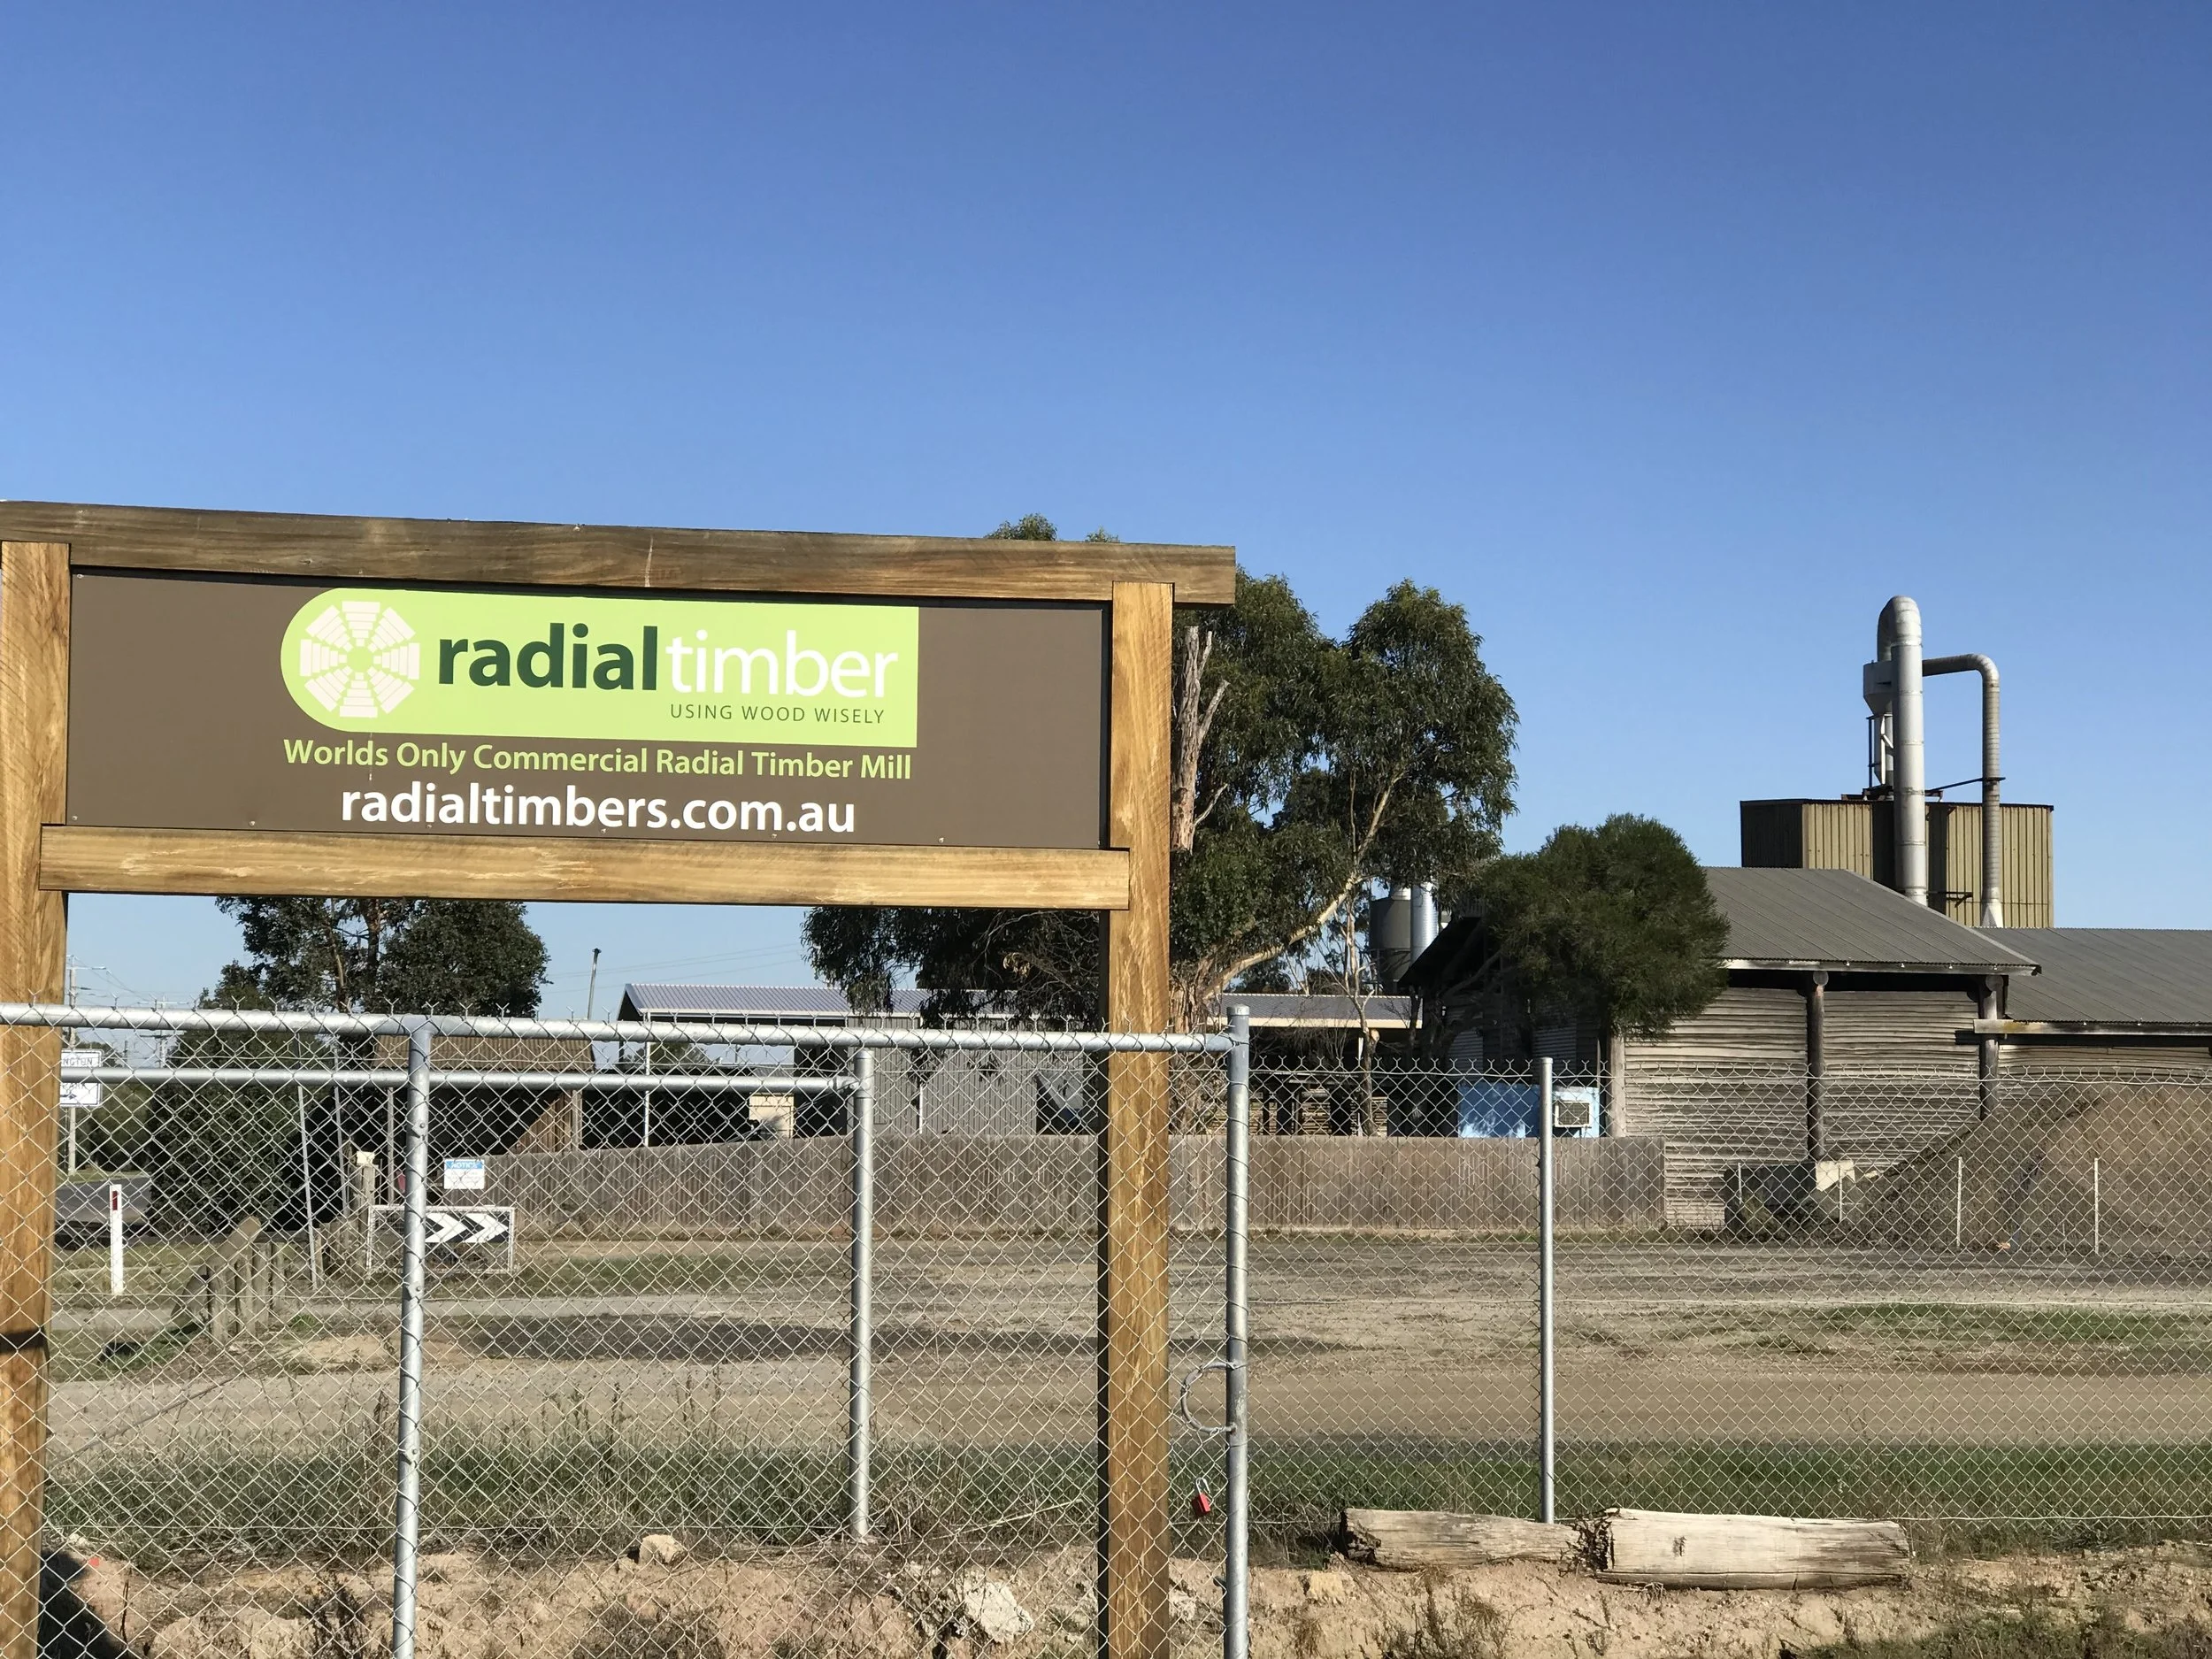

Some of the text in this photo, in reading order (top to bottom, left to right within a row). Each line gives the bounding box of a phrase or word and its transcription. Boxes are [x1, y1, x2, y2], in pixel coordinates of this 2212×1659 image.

[671, 703, 885, 725] USING WOOD WISELY
[283, 738, 911, 780] Worlds Only Commercial Radial Timber Mill
[342, 780, 855, 833] radialtimbers.com.au
